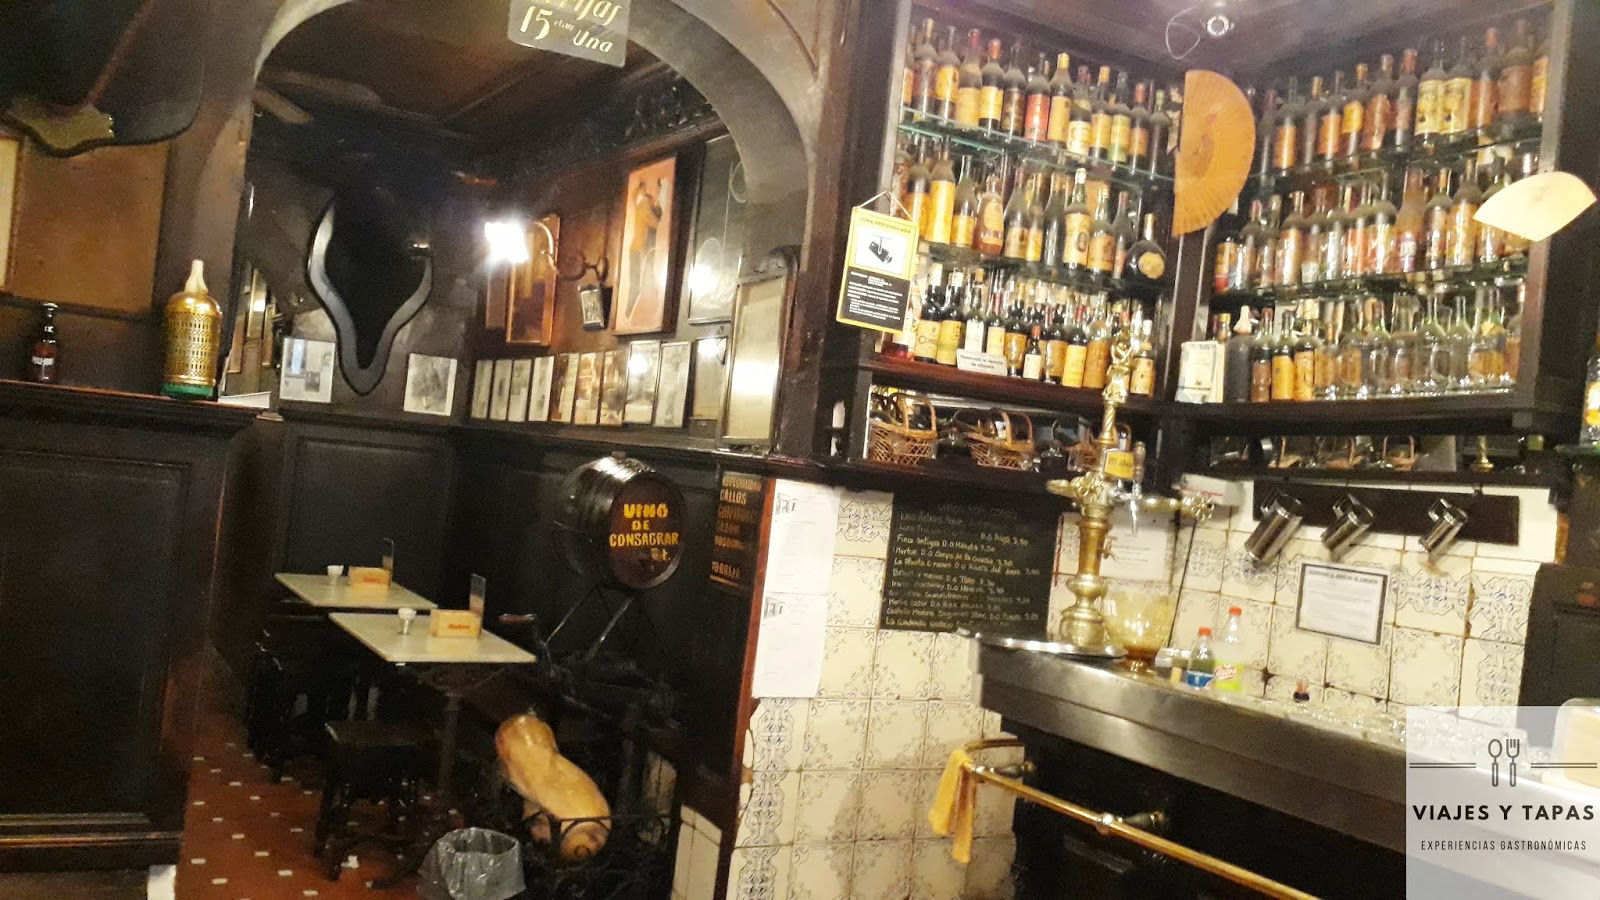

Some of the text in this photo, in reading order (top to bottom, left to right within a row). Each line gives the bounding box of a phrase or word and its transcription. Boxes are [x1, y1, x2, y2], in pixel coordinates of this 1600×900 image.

[520, 6, 553, 40] 15
[573, 30, 613, 52] Una
[720, 488, 747, 505] CALLOS
[623, 502, 669, 519] VINO
[631, 520, 650, 531] DE
[609, 532, 679, 548] CONSAGRAR
